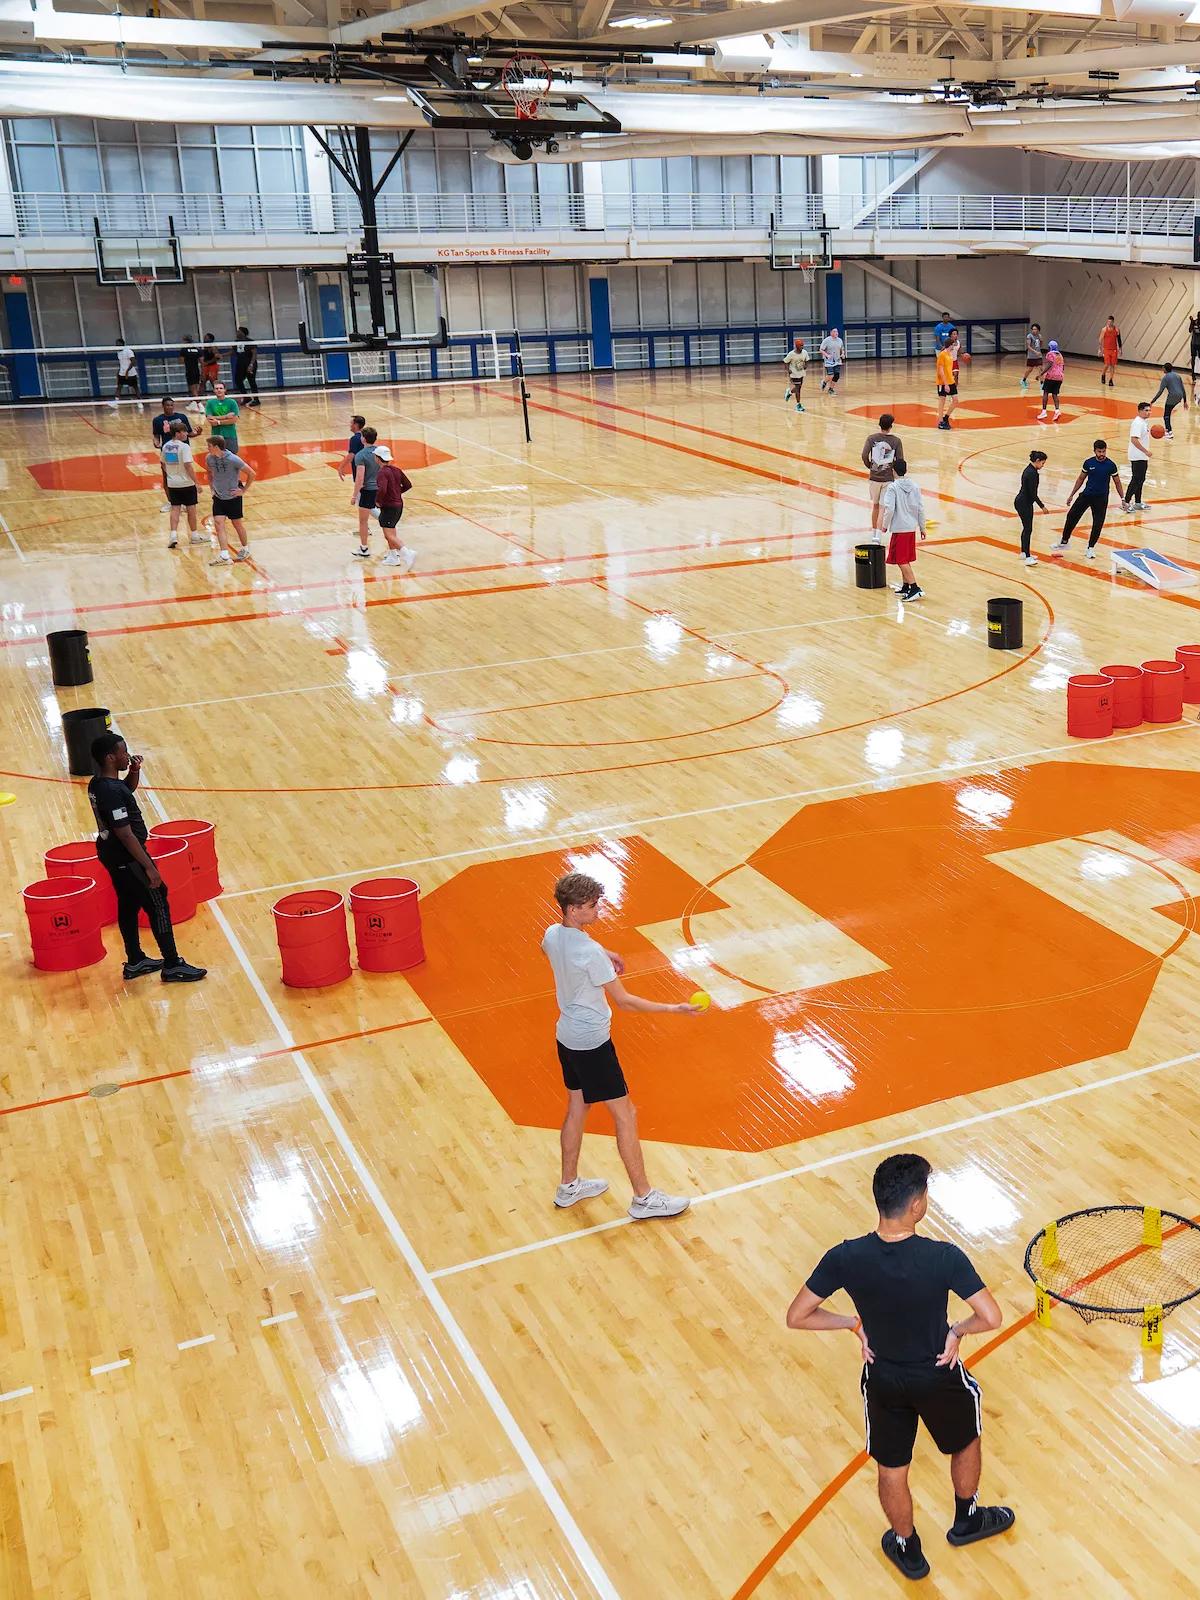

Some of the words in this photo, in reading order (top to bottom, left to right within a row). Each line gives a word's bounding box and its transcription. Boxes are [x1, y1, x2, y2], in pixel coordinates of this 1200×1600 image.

[465, 248, 489, 258] Sports
[490, 248, 497, 256] &
[498, 248, 523, 256] Fitness
[525, 247, 551, 256] Facility
